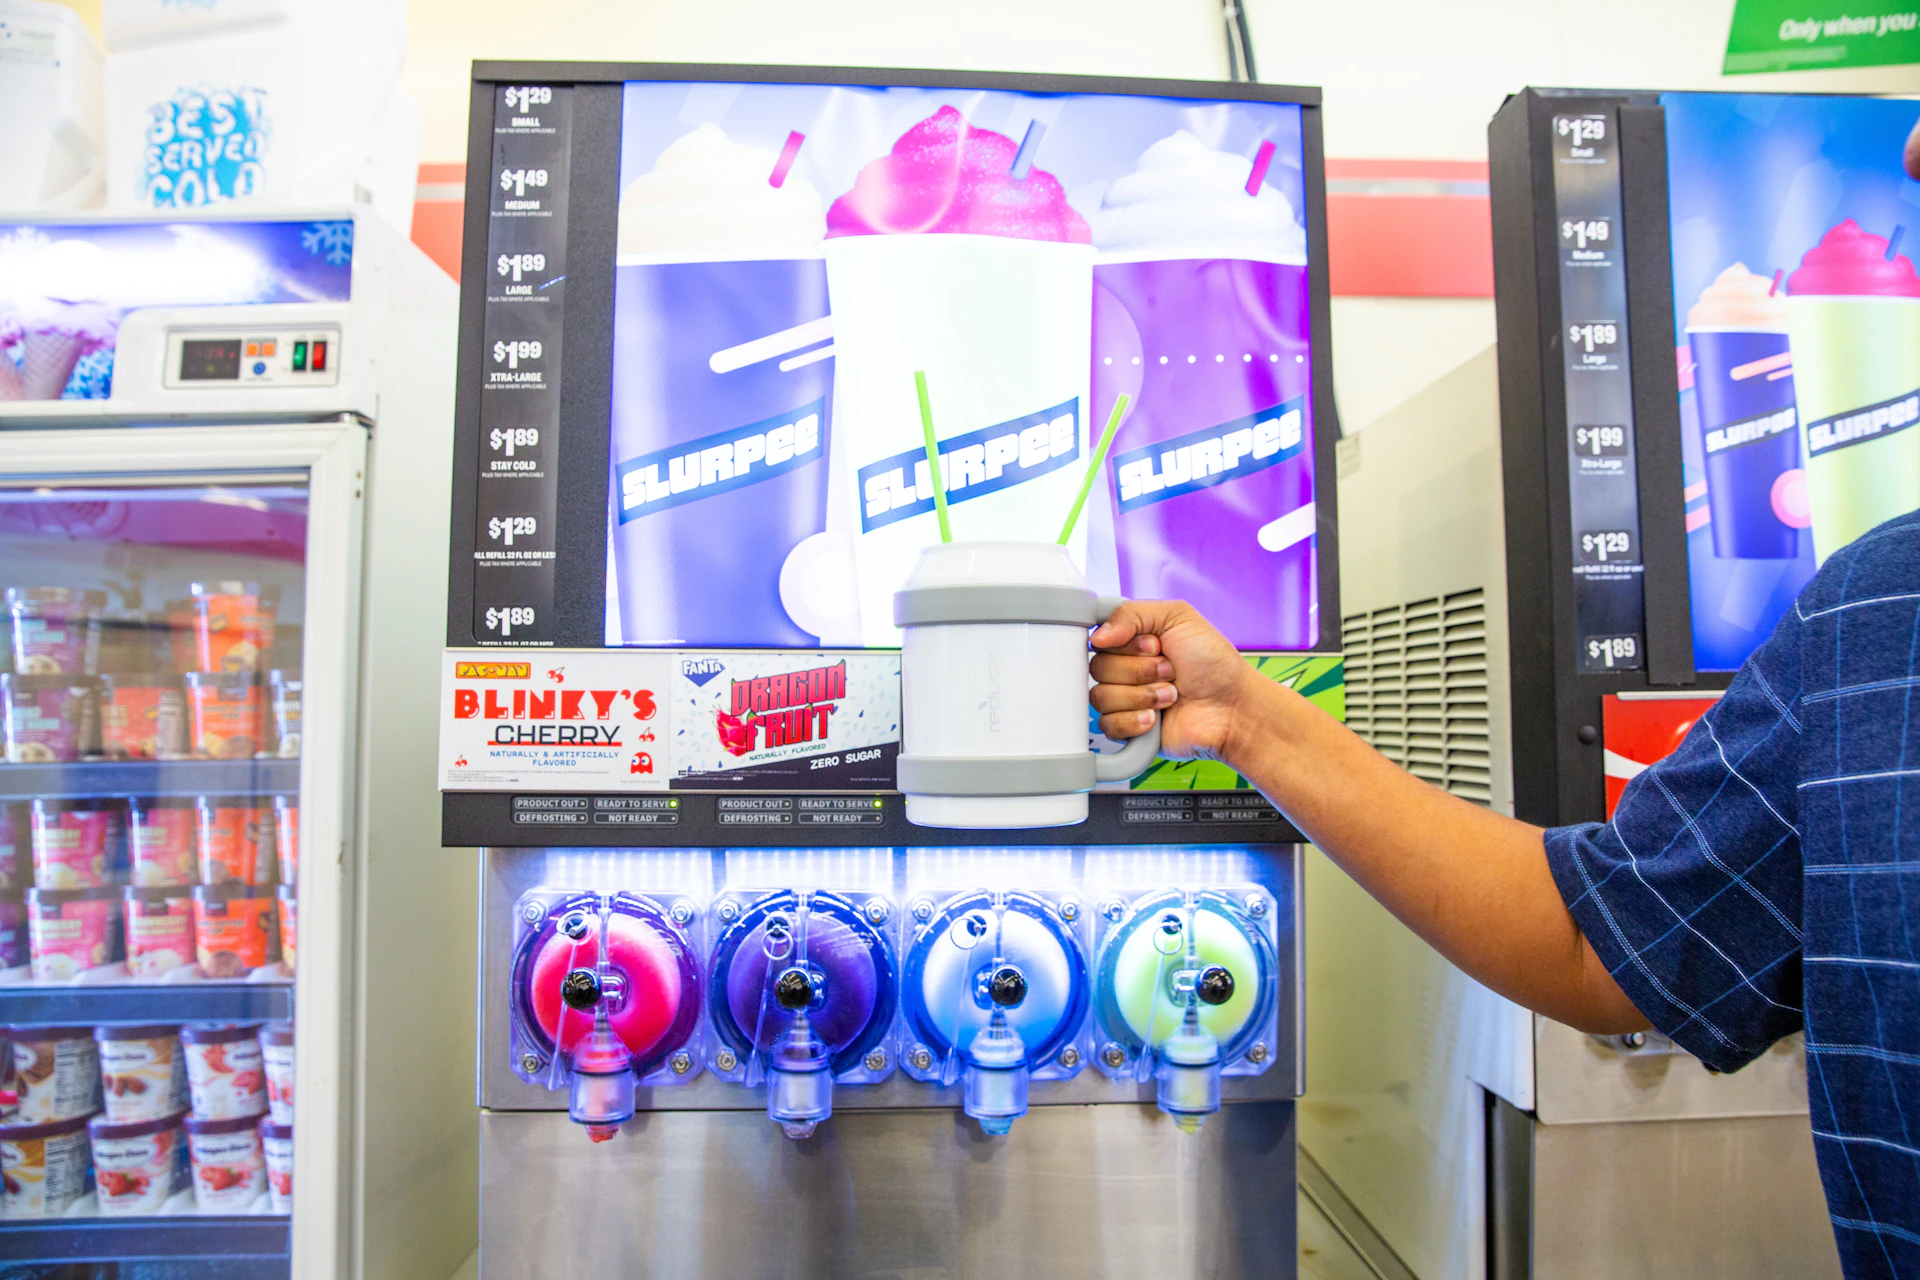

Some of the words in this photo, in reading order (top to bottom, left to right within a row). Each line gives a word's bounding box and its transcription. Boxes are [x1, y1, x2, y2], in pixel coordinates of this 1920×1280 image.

[1779, 18, 1822, 42] Only
[1824, 14, 1877, 37] when
[1877, 12, 1918, 37] you
[511, 117, 540, 127] SMALL
[505, 200, 540, 210] MEDIUM
[506, 285, 532, 295] LARGE
[490, 372, 542, 382] XTRA-LARGE
[490, 461, 512, 470] STAY
[513, 461, 536, 470] COLD
[458, 664, 528, 677] PAC-MAN
[682, 659, 723, 676] FANTA
[731, 659, 846, 717] DRAGON
[454, 689, 657, 721] BLINKY'S
[745, 703, 835, 752] FRUIT
[495, 725, 620, 745] CHERRY
[749, 750, 787, 761] NATURALLY
[791, 743, 827, 755] FLAVORED
[810, 756, 840, 770] ZERO
[845, 749, 881, 764] SUGAR
[517, 799, 558, 808] PRODUCT
[561, 799, 580, 808] OUT
[597, 799, 627, 808] READY
[628, 799, 639, 808] TO
[642, 799, 670, 808] SERVE
[721, 800, 761, 808] PRODUCT
[763, 800, 783, 808] OUT
[801, 800, 832, 808] READY
[833, 800, 844, 808] TO
[846, 800, 874, 808] SERVE
[1125, 798, 1165, 806] PRODUCT
[1167, 798, 1185, 806] OUT
[519, 814, 577, 822] DEFROSTING
[608, 814, 627, 822] NOT
[629, 814, 658, 822] READY
[724, 814, 781, 822] DEFROSTING
[812, 814, 831, 822] NOT
[833, 814, 863, 822] READY
[1128, 812, 1183, 820] DEFROSTING
[1212, 811, 1230, 819] NOT
[1231, 811, 1259, 819] READY
